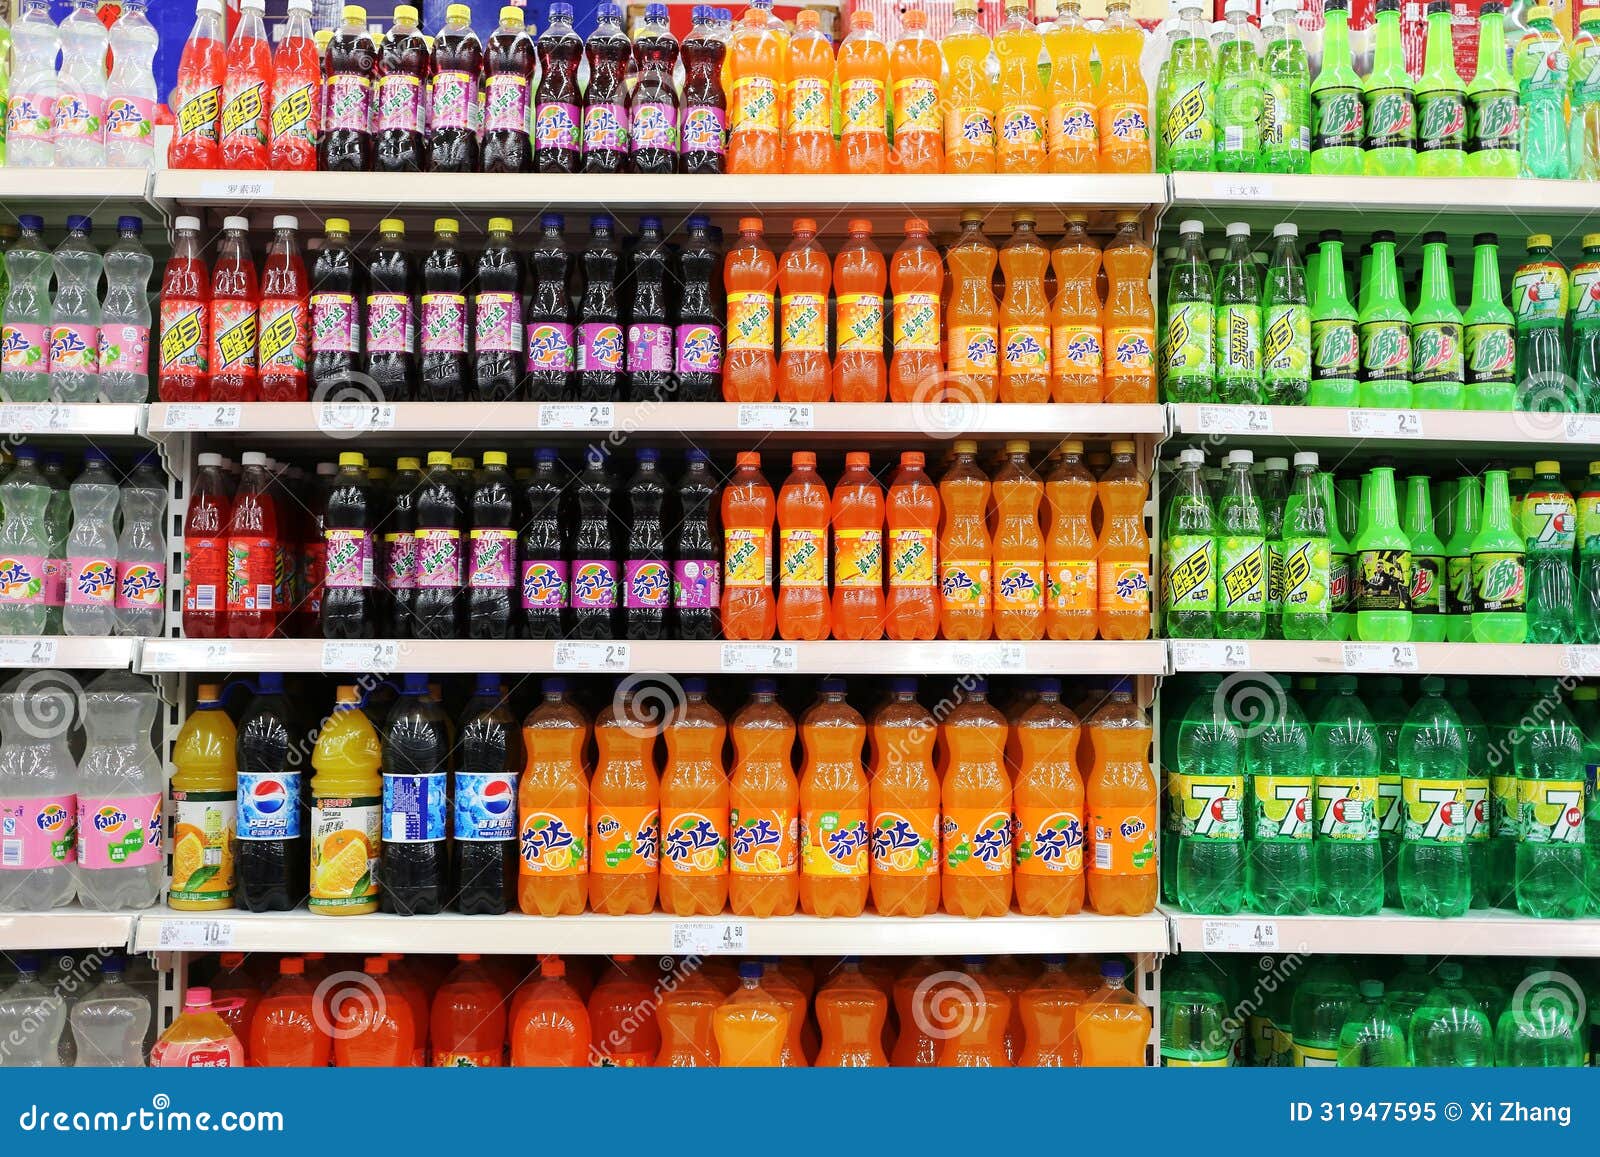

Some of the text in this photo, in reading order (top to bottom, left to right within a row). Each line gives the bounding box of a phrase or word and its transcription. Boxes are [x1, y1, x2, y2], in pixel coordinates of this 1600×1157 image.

[536, 112, 574, 139] 芬达
[584, 112, 620, 141] 芬达
[632, 110, 670, 138] 芬达
[685, 111, 721, 142] 芬达
[963, 115, 993, 143] 芬达
[1004, 115, 1036, 143] 芬达
[1063, 113, 1095, 140] 芬达
[1113, 113, 1146, 140] 芬达
[316, 305, 349, 338] 美年达
[369, 307, 401, 339] 美年达
[430, 306, 459, 337] 美年达
[475, 307, 506, 338] 美年达
[738, 307, 770, 343] 美年达
[786, 307, 818, 339] 美年达
[851, 307, 881, 339] 美年达
[901, 307, 933, 339] 美年达
[530, 335, 568, 361] 芬达
[591, 334, 623, 361] 芬达
[683, 334, 721, 361] 芬达
[967, 339, 997, 361] 芬达
[1006, 338, 1040, 361] 芬达
[1068, 339, 1100, 361] 芬达
[1116, 339, 1149, 362] 芬达
[1230, 309, 1249, 368] SMART
[215, 407, 224, 423] 2
[371, 406, 379, 423] 2
[590, 406, 598, 422] 2
[789, 407, 798, 424] 2
[1248, 410, 1256, 427] 2
[1398, 414, 1407, 431] 2
[327, 544, 357, 576] 美年达
[424, 543, 455, 576] 美年达
[726, 541, 757, 575] 美年达
[784, 541, 816, 574] 美年达
[857, 541, 881, 575] 美年达
[894, 541, 926, 574] 美年达
[79, 567, 116, 593] 芬达
[122, 572, 161, 597] 芬达
[523, 573, 562, 597] 芬达
[576, 570, 613, 596] 芬达
[632, 570, 671, 597] 芬达
[942, 573, 972, 598] 芬达
[1000, 573, 1032, 598] 芬达
[1115, 574, 1147, 598] 芬达
[1171, 545, 1211, 601] 醒目
[1226, 545, 1264, 603] 醒目
[32, 642, 42, 659] 2
[373, 644, 382, 662] 2
[606, 645, 614, 662] 2
[773, 647, 781, 664] 2
[1225, 645, 1234, 662] 2
[1392, 646, 1401, 663] 2
[37, 808, 67, 831] Fanta
[94, 808, 127, 832] Fanta
[249, 818, 287, 828] PEPSI
[478, 819, 513, 829] 百事可乐
[597, 820, 620, 834] Fanta
[1120, 820, 1146, 837] Fanta
[522, 820, 574, 860] 芬达
[666, 820, 720, 861] 芬达
[733, 819, 780, 856] 芬达
[871, 820, 919, 860] 芬达
[1035, 820, 1083, 861] 芬达
[203, 924, 219, 941] 10
[723, 926, 732, 943] 4
[1254, 925, 1262, 942] 4
